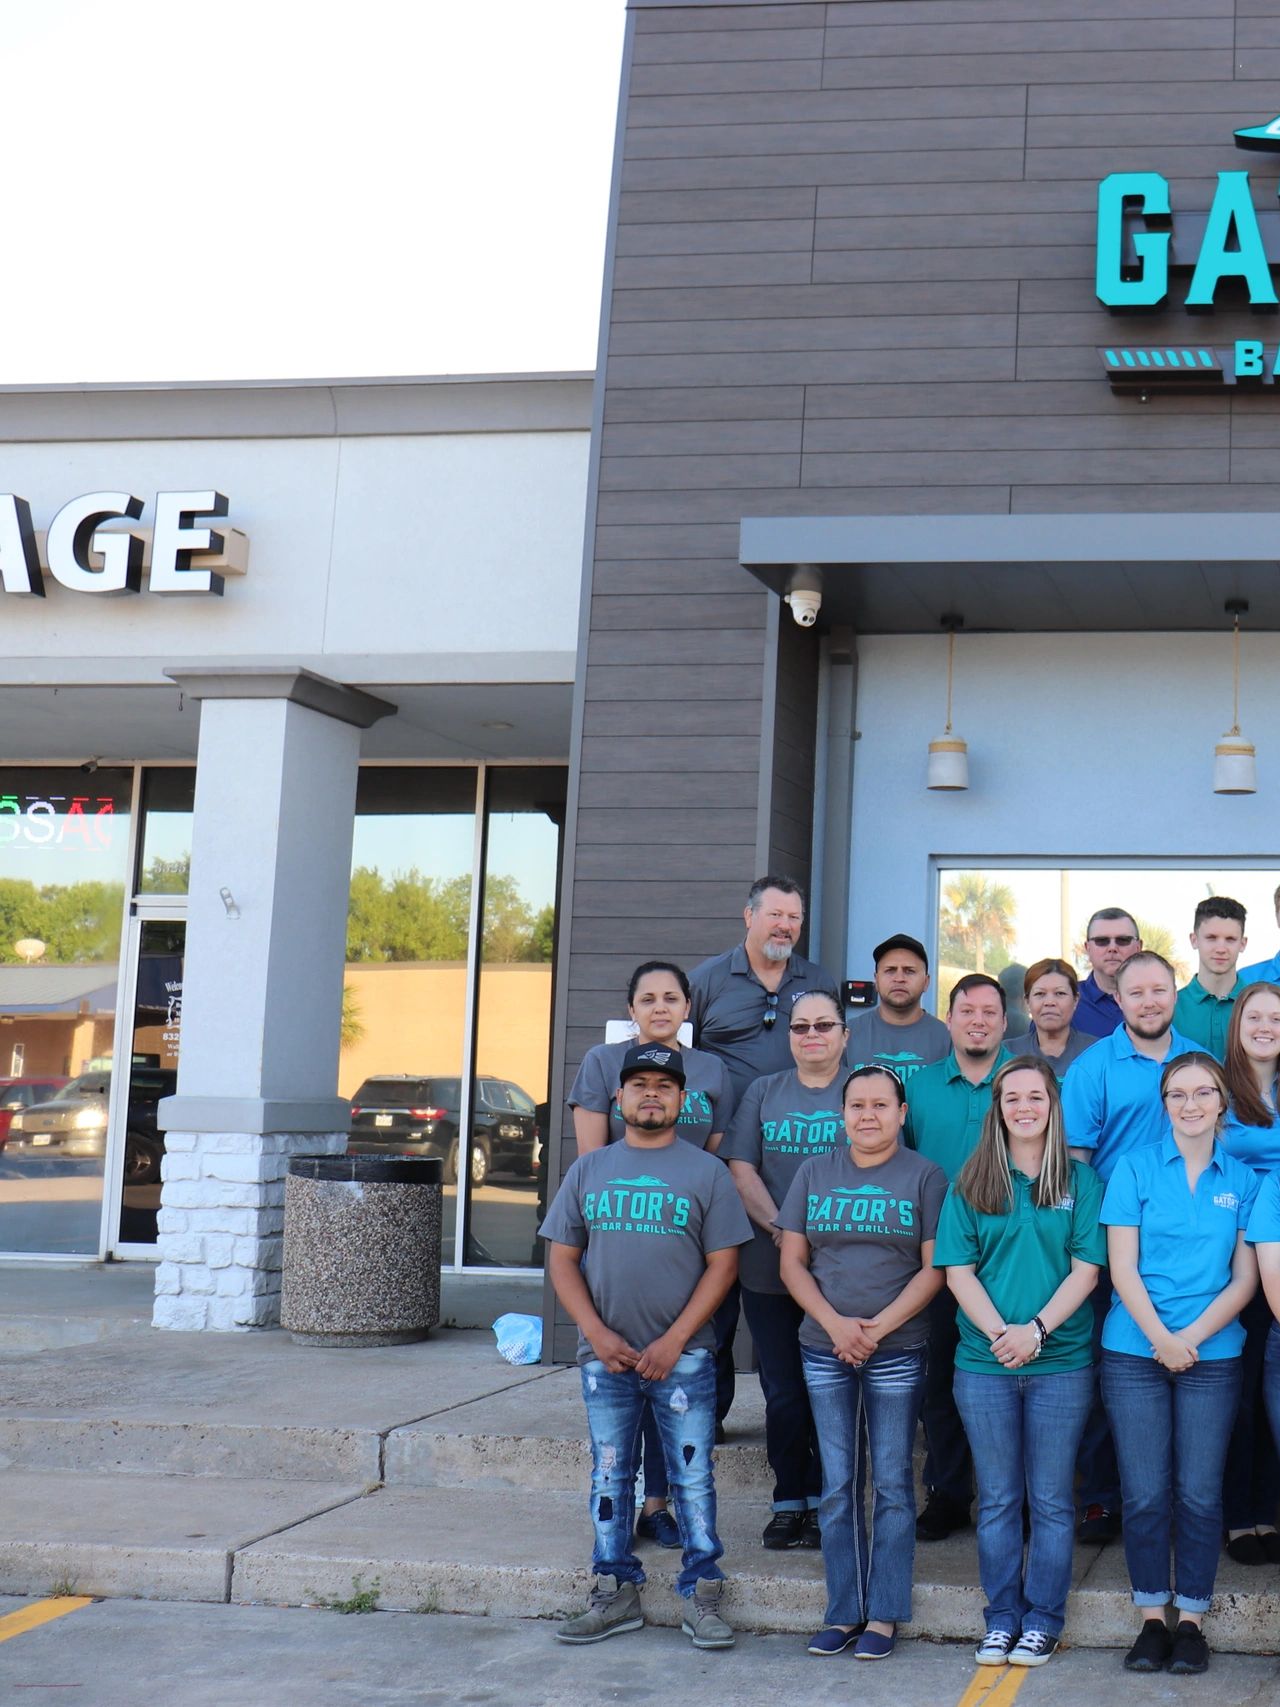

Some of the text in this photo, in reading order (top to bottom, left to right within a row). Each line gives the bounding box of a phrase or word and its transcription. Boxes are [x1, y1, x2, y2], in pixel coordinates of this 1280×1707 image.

[763, 1119, 853, 1145] GATOR'
[781, 1145, 800, 1154] BAR
[584, 1190, 691, 1227] GATOR'S
[807, 1194, 914, 1227] GATOR'S
[601, 1222, 667, 1235] BAR & GRILL
[818, 1223, 891, 1235] BAR & GRILL
